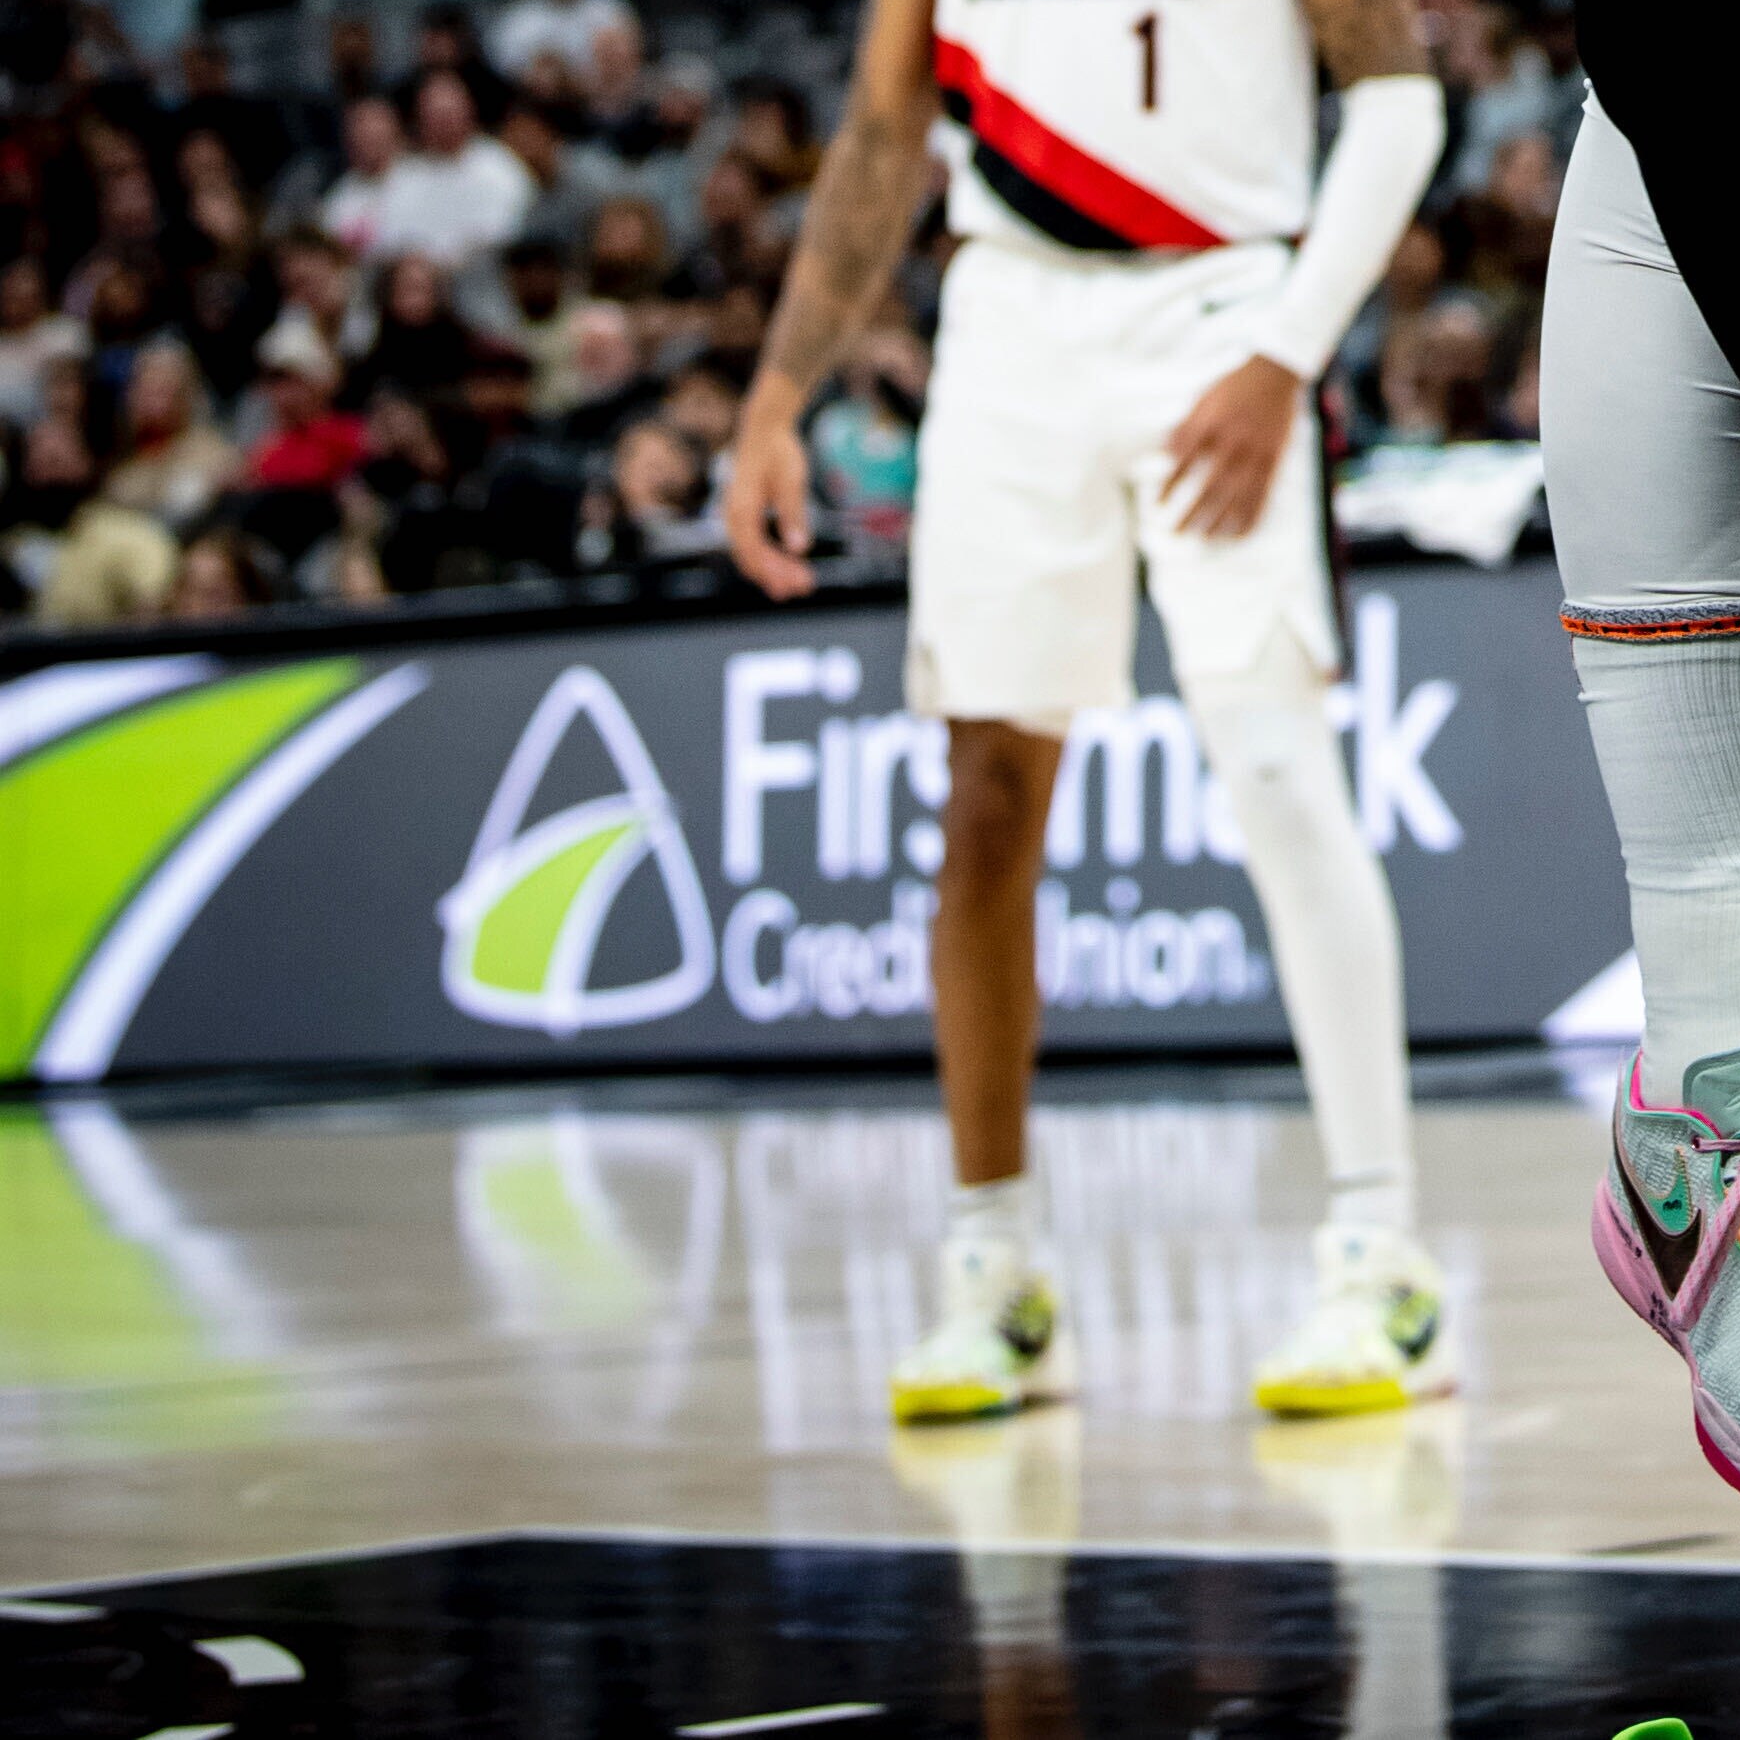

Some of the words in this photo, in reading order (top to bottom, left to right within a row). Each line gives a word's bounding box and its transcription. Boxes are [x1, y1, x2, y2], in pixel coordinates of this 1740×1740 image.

[1131, 8, 1161, 117] 1
[721, 595, 1464, 886] Firsmk
[722, 887, 938, 1024] Credi
